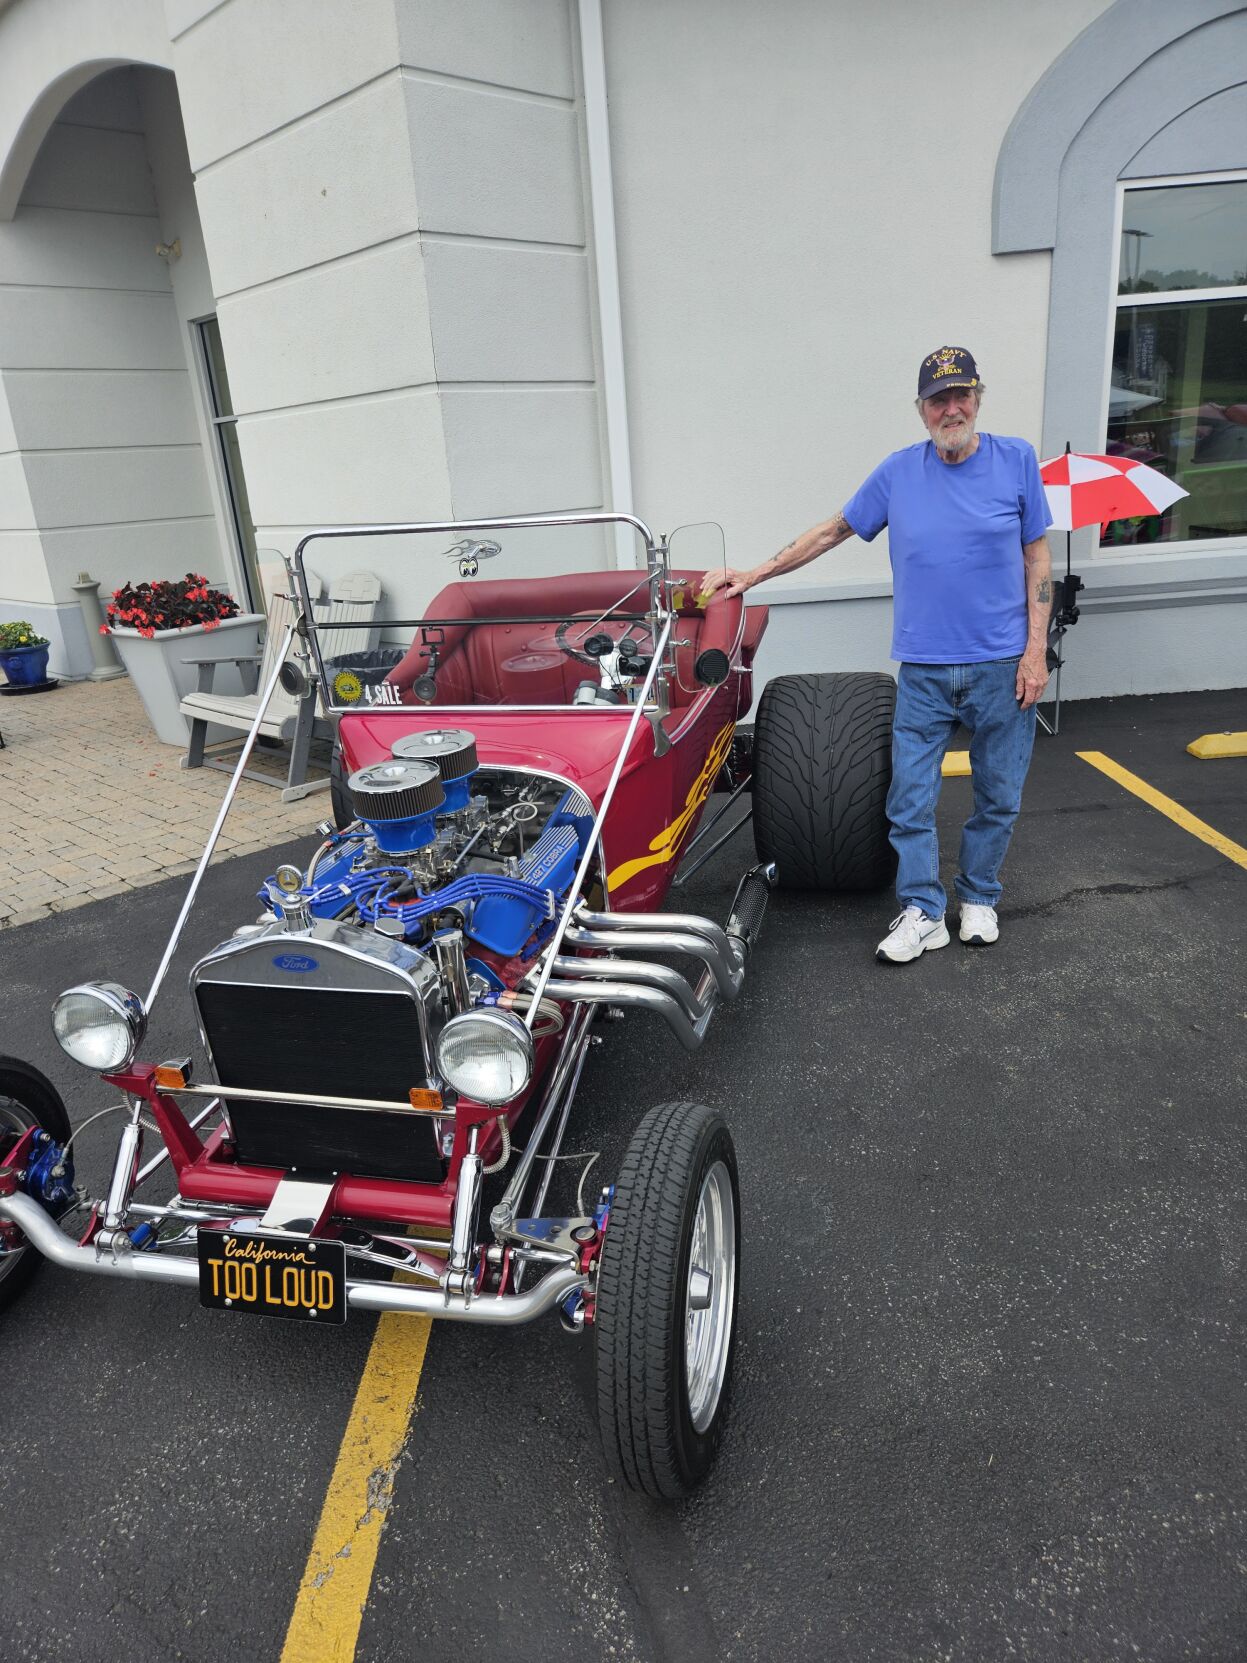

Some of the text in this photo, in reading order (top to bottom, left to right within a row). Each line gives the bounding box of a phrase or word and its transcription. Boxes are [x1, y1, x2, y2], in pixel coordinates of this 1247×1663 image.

[942, 349, 967, 358] NAVY
[932, 368, 962, 379] VETERAN
[365, 684, 403, 705] 4 SALE
[543, 843, 566, 867] COBRA
[282, 956, 309, 969] Ford
[225, 1238, 316, 1264] California
[207, 1258, 334, 1310] TOO LOUD
